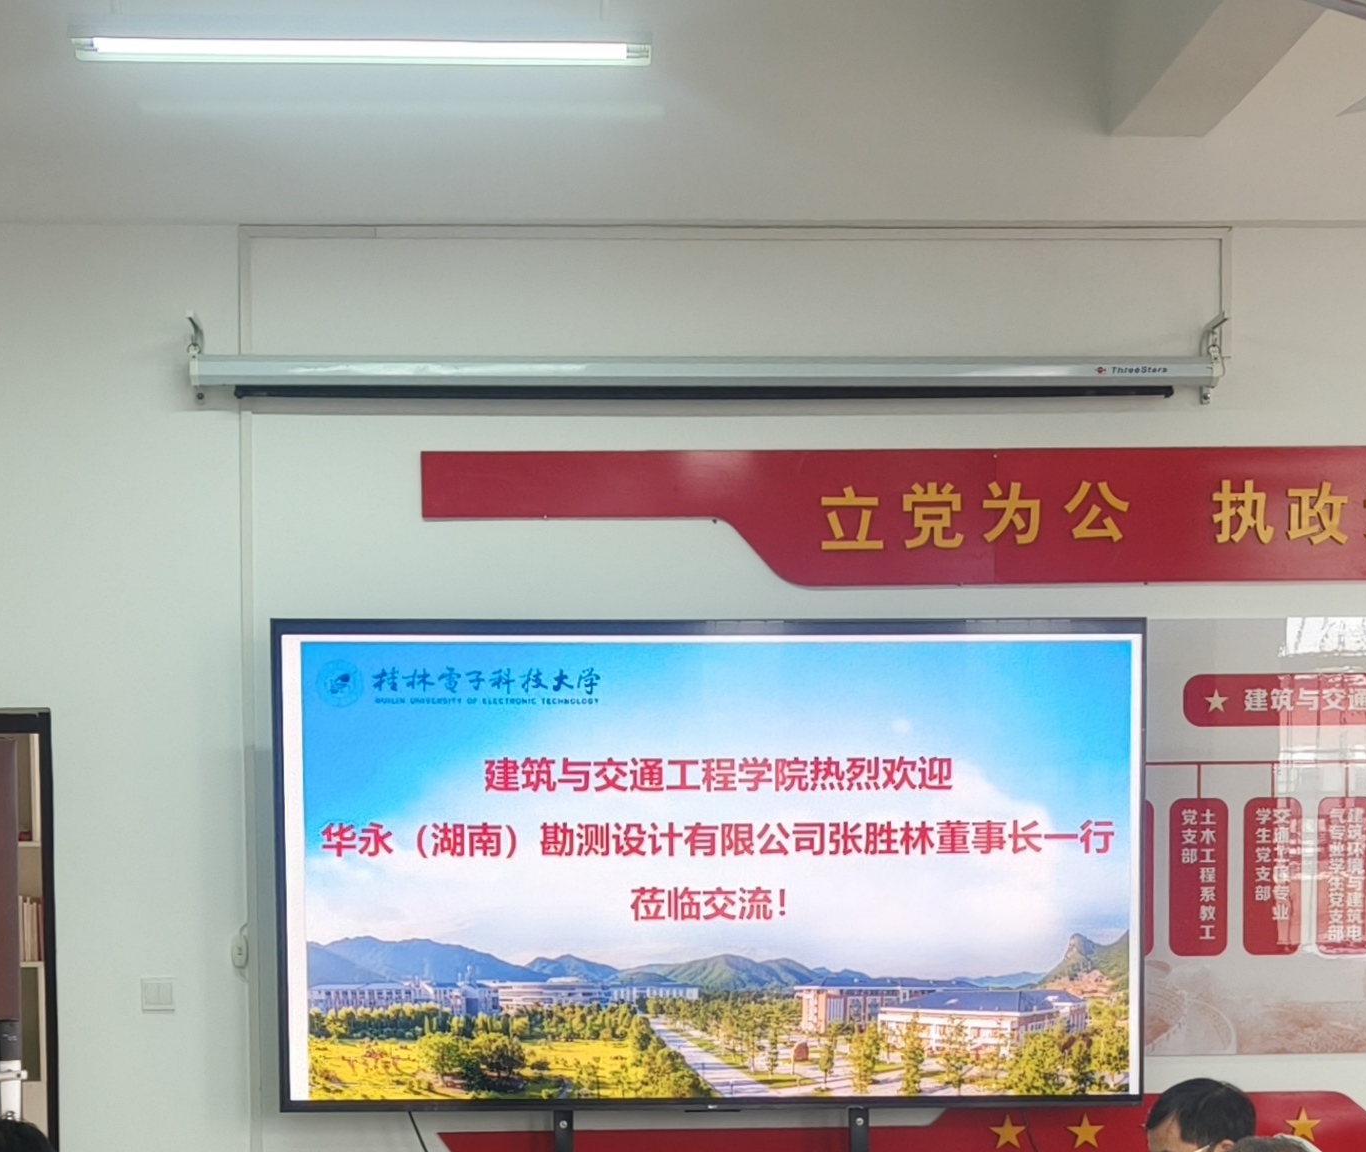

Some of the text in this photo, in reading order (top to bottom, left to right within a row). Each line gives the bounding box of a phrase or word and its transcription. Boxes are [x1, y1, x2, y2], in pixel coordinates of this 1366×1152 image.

[1111, 366, 1168, 374] ThreeStars
[820, 480, 1130, 551] 立党为公
[409, 697, 462, 705] UNIVERSITY
[466, 697, 477, 705] OF
[482, 697, 537, 705] ELECTRONIC
[541, 697, 599, 705] TECHNOLOGY
[484, 756, 953, 793] 建筑与交通工程学院热烈欢迎
[321, 820, 1115, 858] 华永（湖南）勘测设计有限公司张胜林董事长一行
[1181, 809, 1198, 864] 党支部
[1254, 808, 1271, 902] 学生党支部
[1199, 808, 1216, 940] 土木工程系教工
[1272, 808, 1292, 921] 交通工程专业
[630, 886, 788, 922] 莅临交流！
